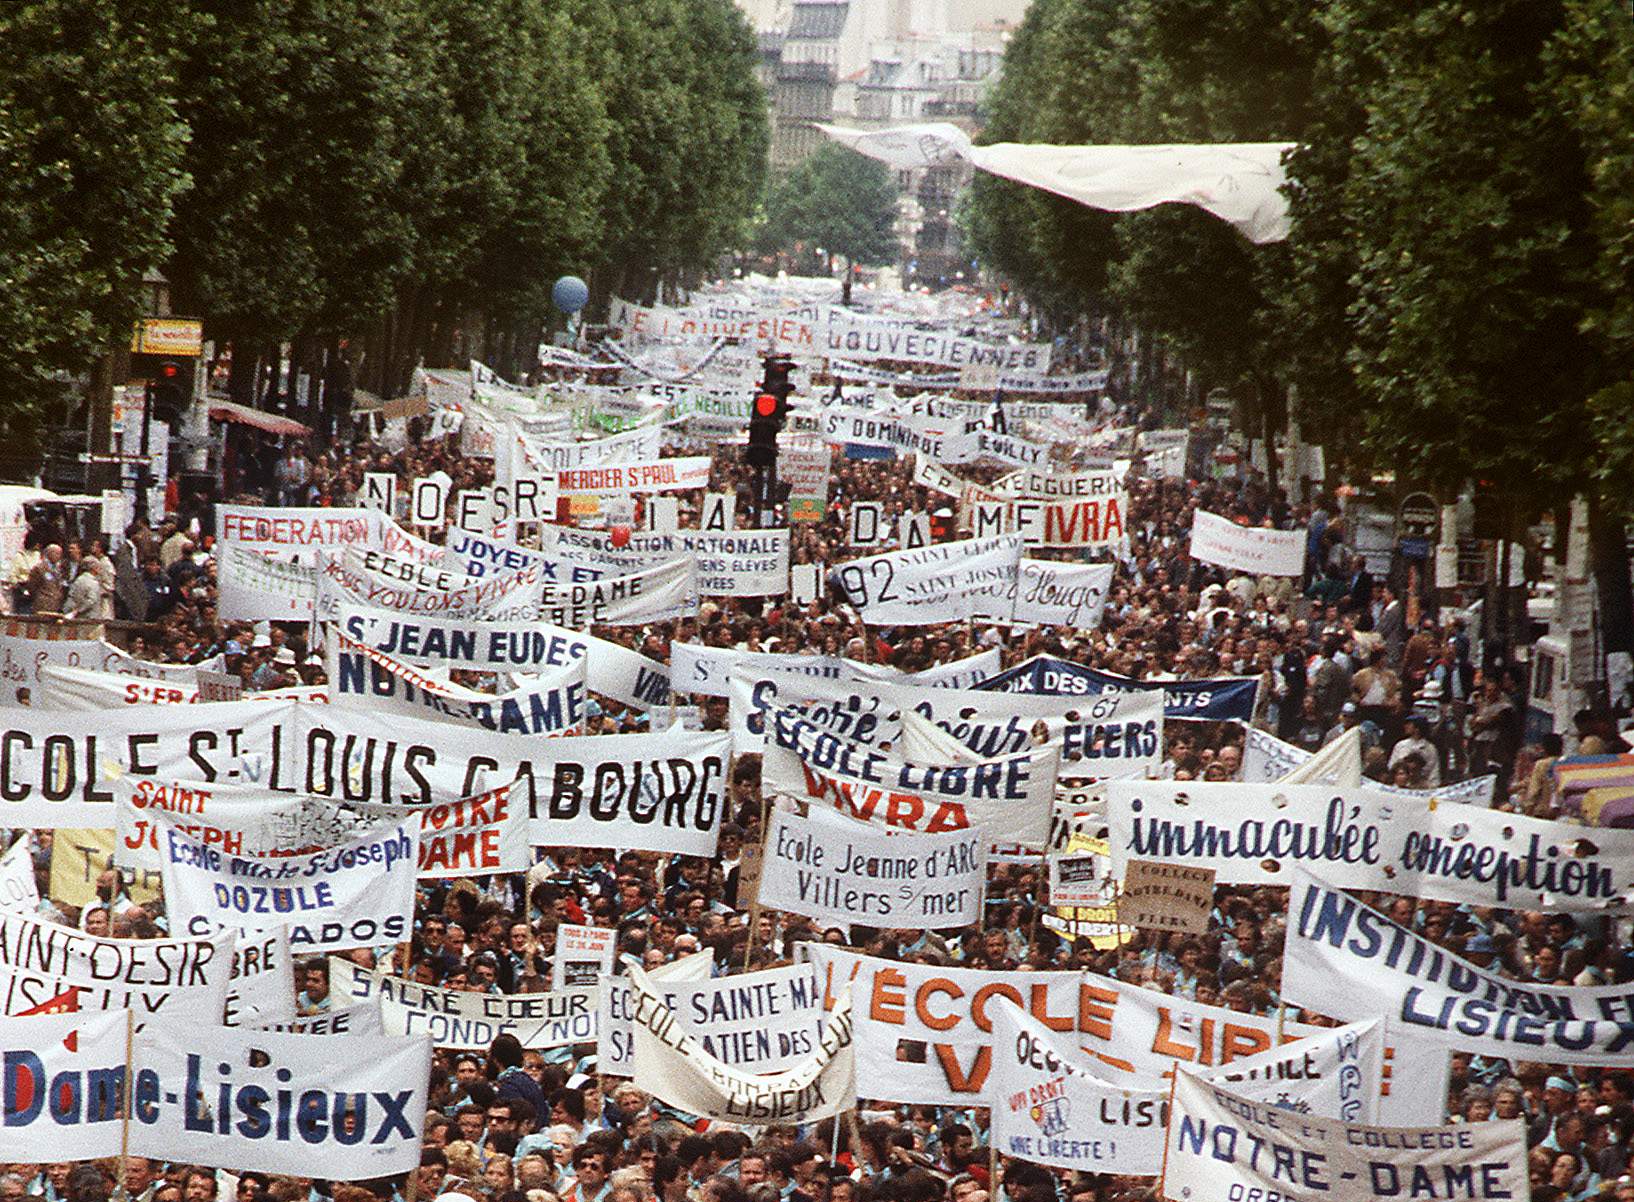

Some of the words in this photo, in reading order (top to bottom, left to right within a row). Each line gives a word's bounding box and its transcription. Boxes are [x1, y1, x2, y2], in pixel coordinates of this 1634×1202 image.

[558, 469, 624, 491] MERCIER
[223, 514, 371, 547] FEDERATION
[684, 536, 779, 553] NATIONALE
[842, 557, 899, 609] 92
[905, 572, 957, 596] SAINT
[377, 624, 477, 661] JEAN
[487, 630, 588, 667] EUDES
[1043, 671, 1088, 694] DES
[469, 680, 584, 735] DAME
[1062, 720, 1157, 760] FLERS
[271, 724, 436, 806] LOUIS
[461, 754, 723, 833] CABOURG
[898, 756, 1031, 800] LIBRE
[776, 825, 825, 869] Ecole
[835, 841, 917, 881] Jeanne
[1125, 797, 1381, 866] immaculée
[1400, 833, 1618, 902] conception
[799, 868, 892, 916] Villers
[823, 960, 1119, 1041] L'ÉCOLE
[725, 1077, 828, 1120] LISIEUX
[1346, 1127, 1474, 1151] COLLEGE
